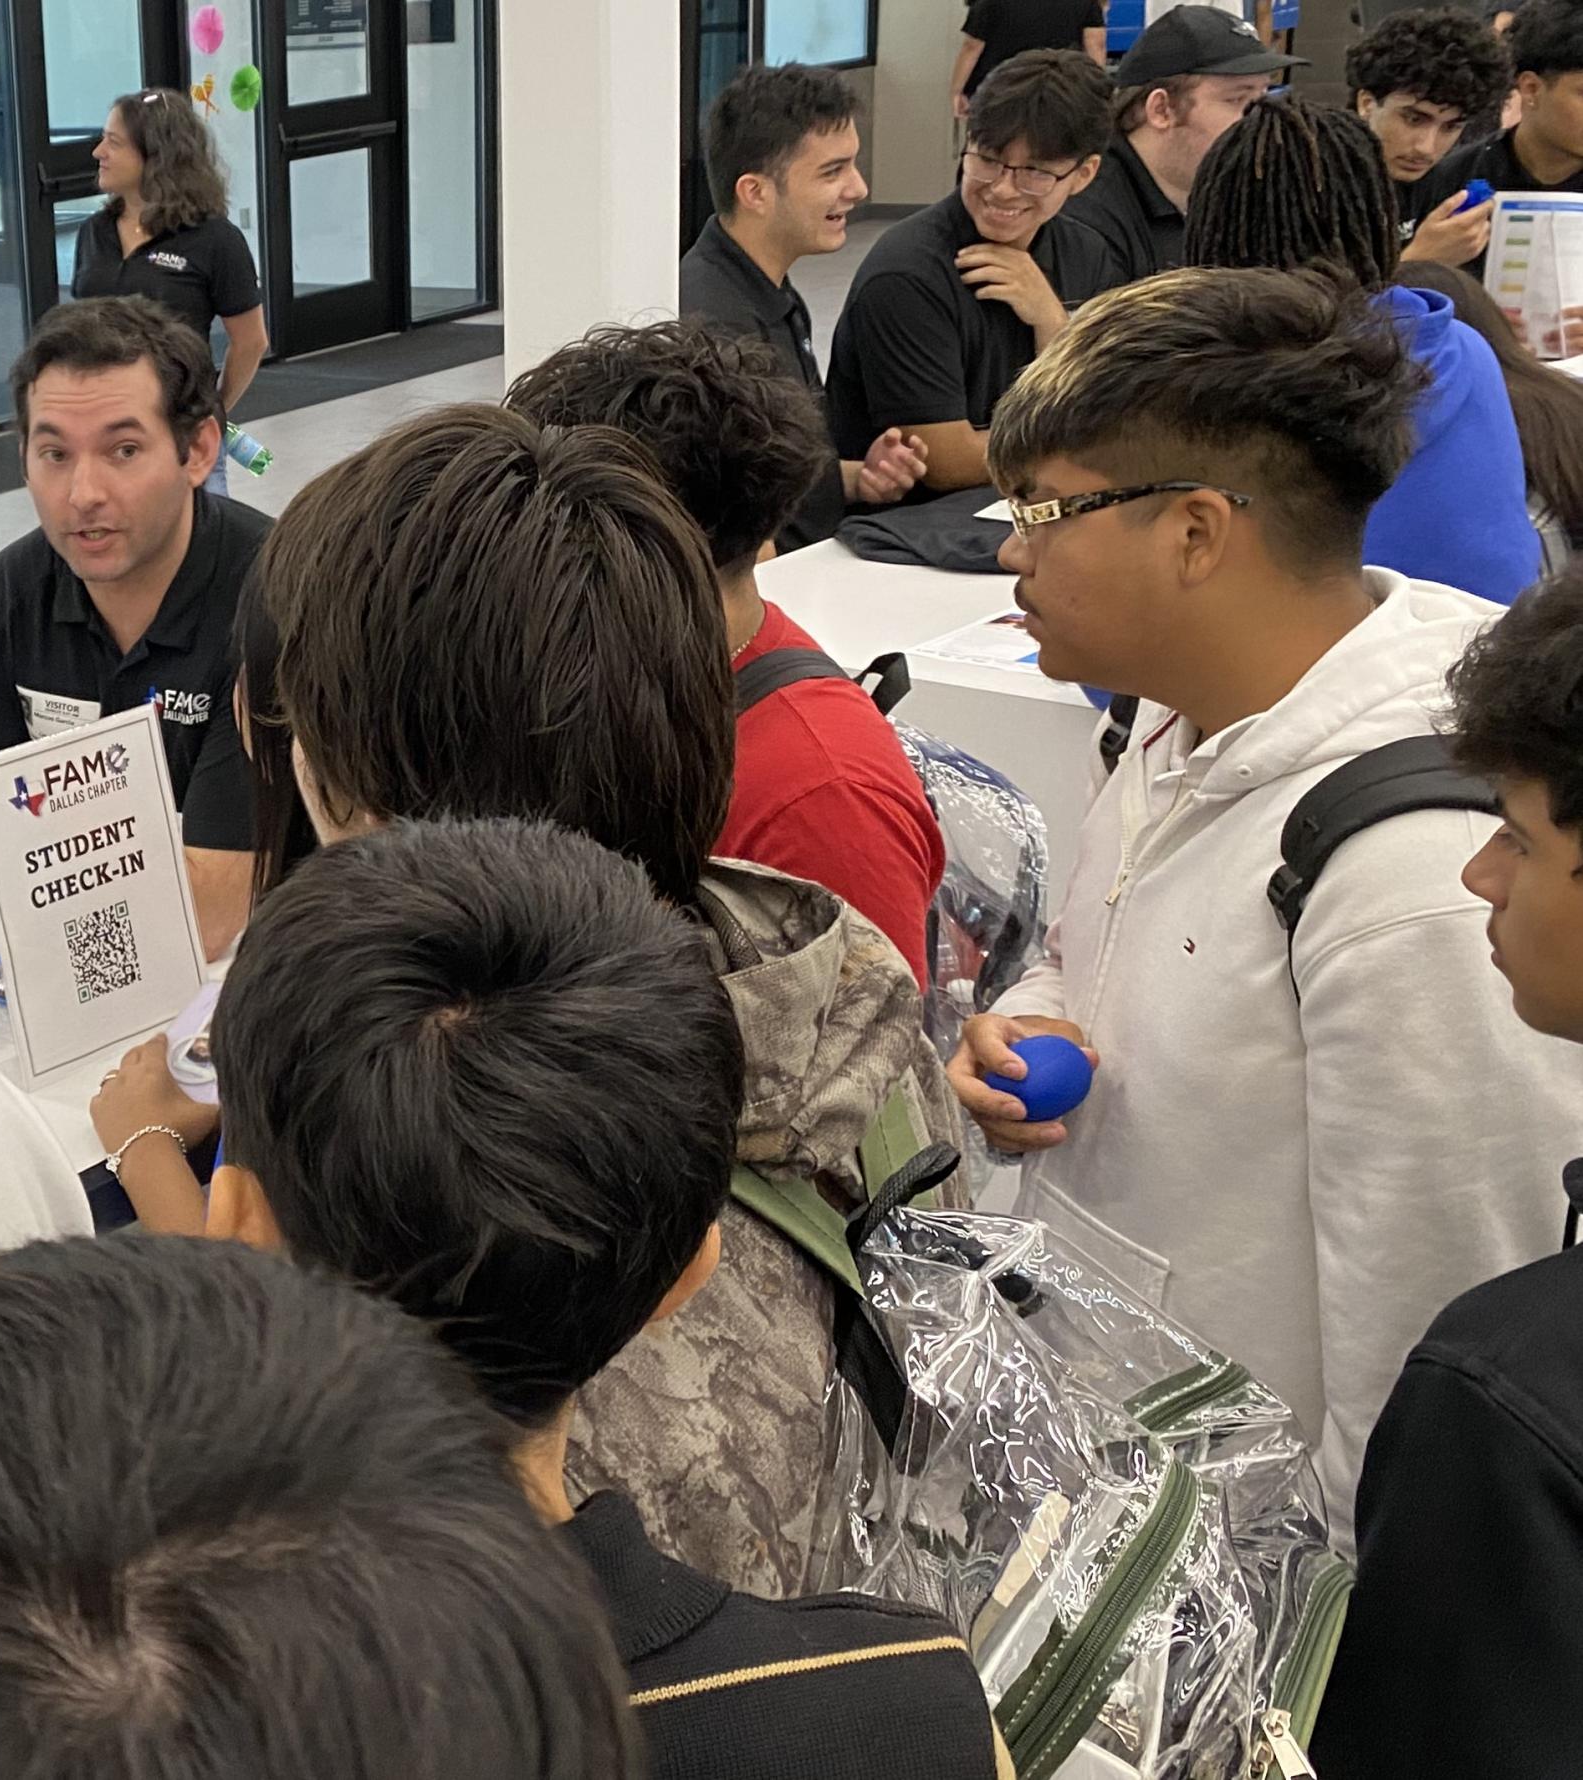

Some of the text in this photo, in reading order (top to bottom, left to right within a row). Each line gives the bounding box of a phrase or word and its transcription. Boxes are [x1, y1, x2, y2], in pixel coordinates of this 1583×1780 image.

[45, 700, 80, 713] VISITOR
[49, 775, 129, 813] DALLAS CHAPTER
[24, 816, 136, 874] STUDENT
[30, 849, 145, 909] CHECK-IN
